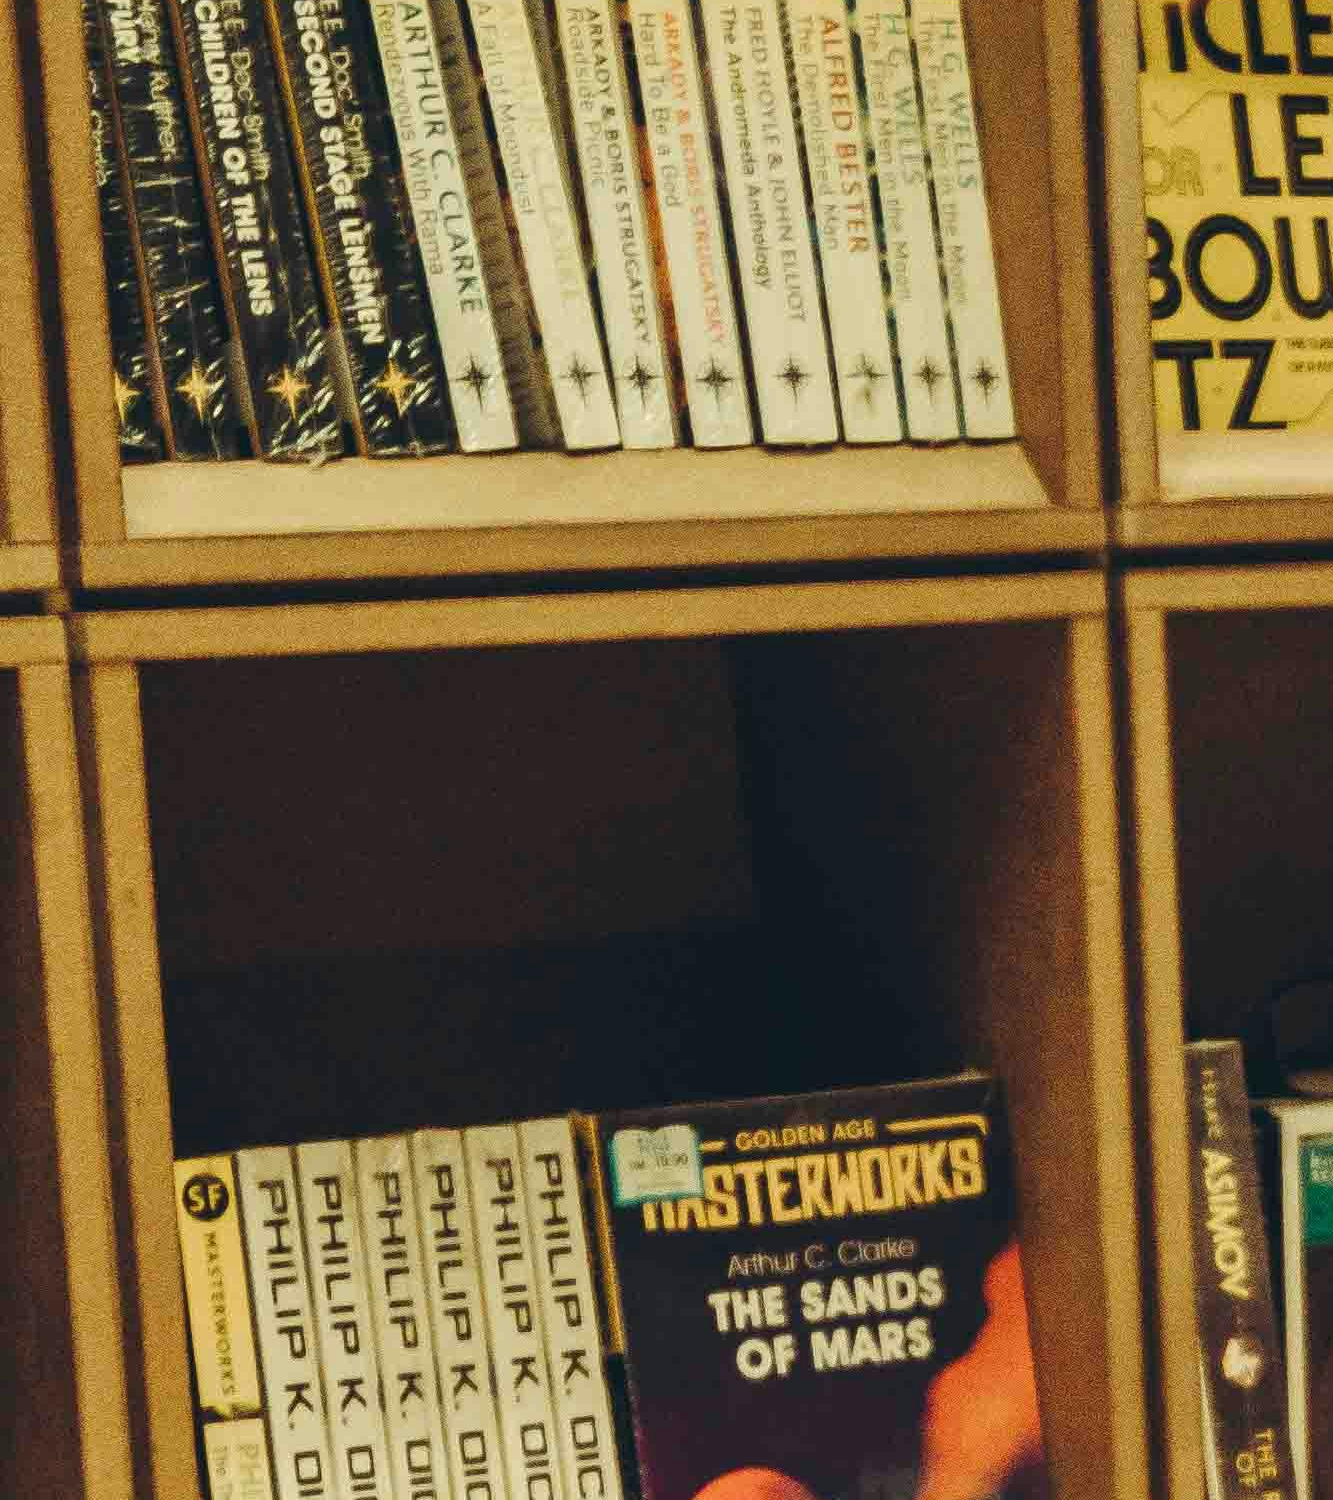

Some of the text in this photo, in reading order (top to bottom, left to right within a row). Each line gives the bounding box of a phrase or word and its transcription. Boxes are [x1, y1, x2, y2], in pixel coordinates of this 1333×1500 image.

[584, 7, 614, 99] ARKADY
[746, 6, 772, 64] FRED
[373, 1, 446, 277] Rendezvous With Rama
[474, 0, 534, 216] A Fall of Moondust
[566, 7, 607, 189] Roadside Picnic
[754, 69, 780, 146] HOYLE
[796, 15, 843, 252] The Demolished Man
[819, 15, 872, 255] ALFRED BESTER
[946, 90, 979, 191] WELLS
[220, 146, 250, 186] OF
[292, 0, 386, 346] SECOND STAGE LENSMEN
[397, 0, 486, 315] ARTHUR C. CLARKE
[604, 128, 630, 195] BORIS
[662, 11, 687, 102] ARKADY
[688, 204, 727, 349] STRUGATSKY
[718, 7, 775, 292] The Andromeda Anthology
[230, 193, 261, 243] THE
[767, 177, 794, 243] JOHN
[240, 249, 274, 317] LENS
[615, 201, 651, 347] STRUGATSKY
[778, 248, 807, 325] ELLIOT
[734, 1119, 877, 1153] GOLDEN AGE
[727, 1250, 799, 1279] Arthur
[837, 1237, 917, 1267] Clarke
[1200, 1148, 1249, 1299] ASIMOV
[257, 1179, 307, 1360] PHILIP
[284, 1382, 314, 1431] K.
[312, 1174, 360, 1355] PHILIP
[336, 1377, 367, 1426] K.
[373, 1171, 419, 1349] PHILIP
[396, 1372, 424, 1419] K.
[425, 1164, 472, 1342] PHILIP
[449, 1363, 479, 1411] K.
[707, 1266, 946, 1333] THE SANDS
[735, 1317, 934, 1380] OF MARS
[1233, 1452, 1257, 1489] OF
[1253, 1427, 1279, 1480] THE
